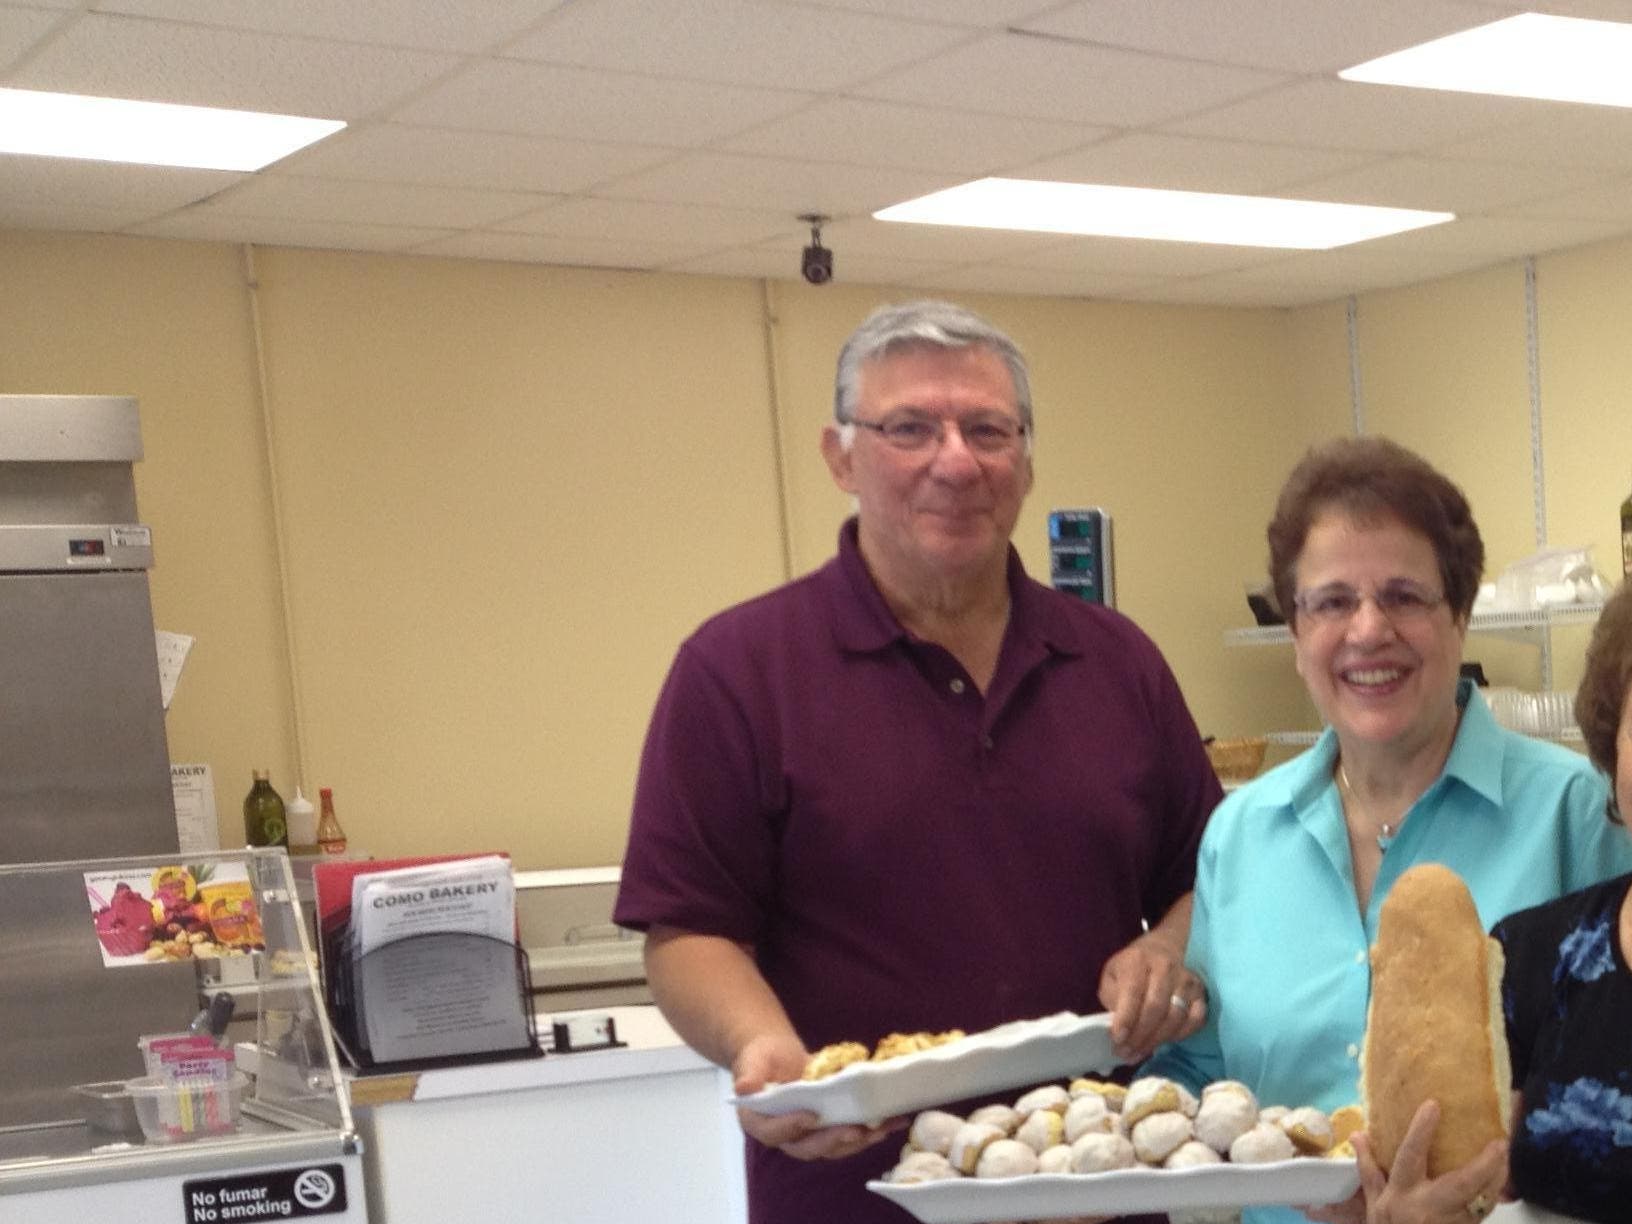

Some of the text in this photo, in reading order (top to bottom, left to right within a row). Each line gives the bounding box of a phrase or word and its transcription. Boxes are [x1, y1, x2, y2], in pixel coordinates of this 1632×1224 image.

[171, 766, 206, 776] AKERY
[373, 882, 499, 910] COMO BAKERY
[191, 1186, 268, 1206] No fumar
[193, 1199, 292, 1222] No smoking
